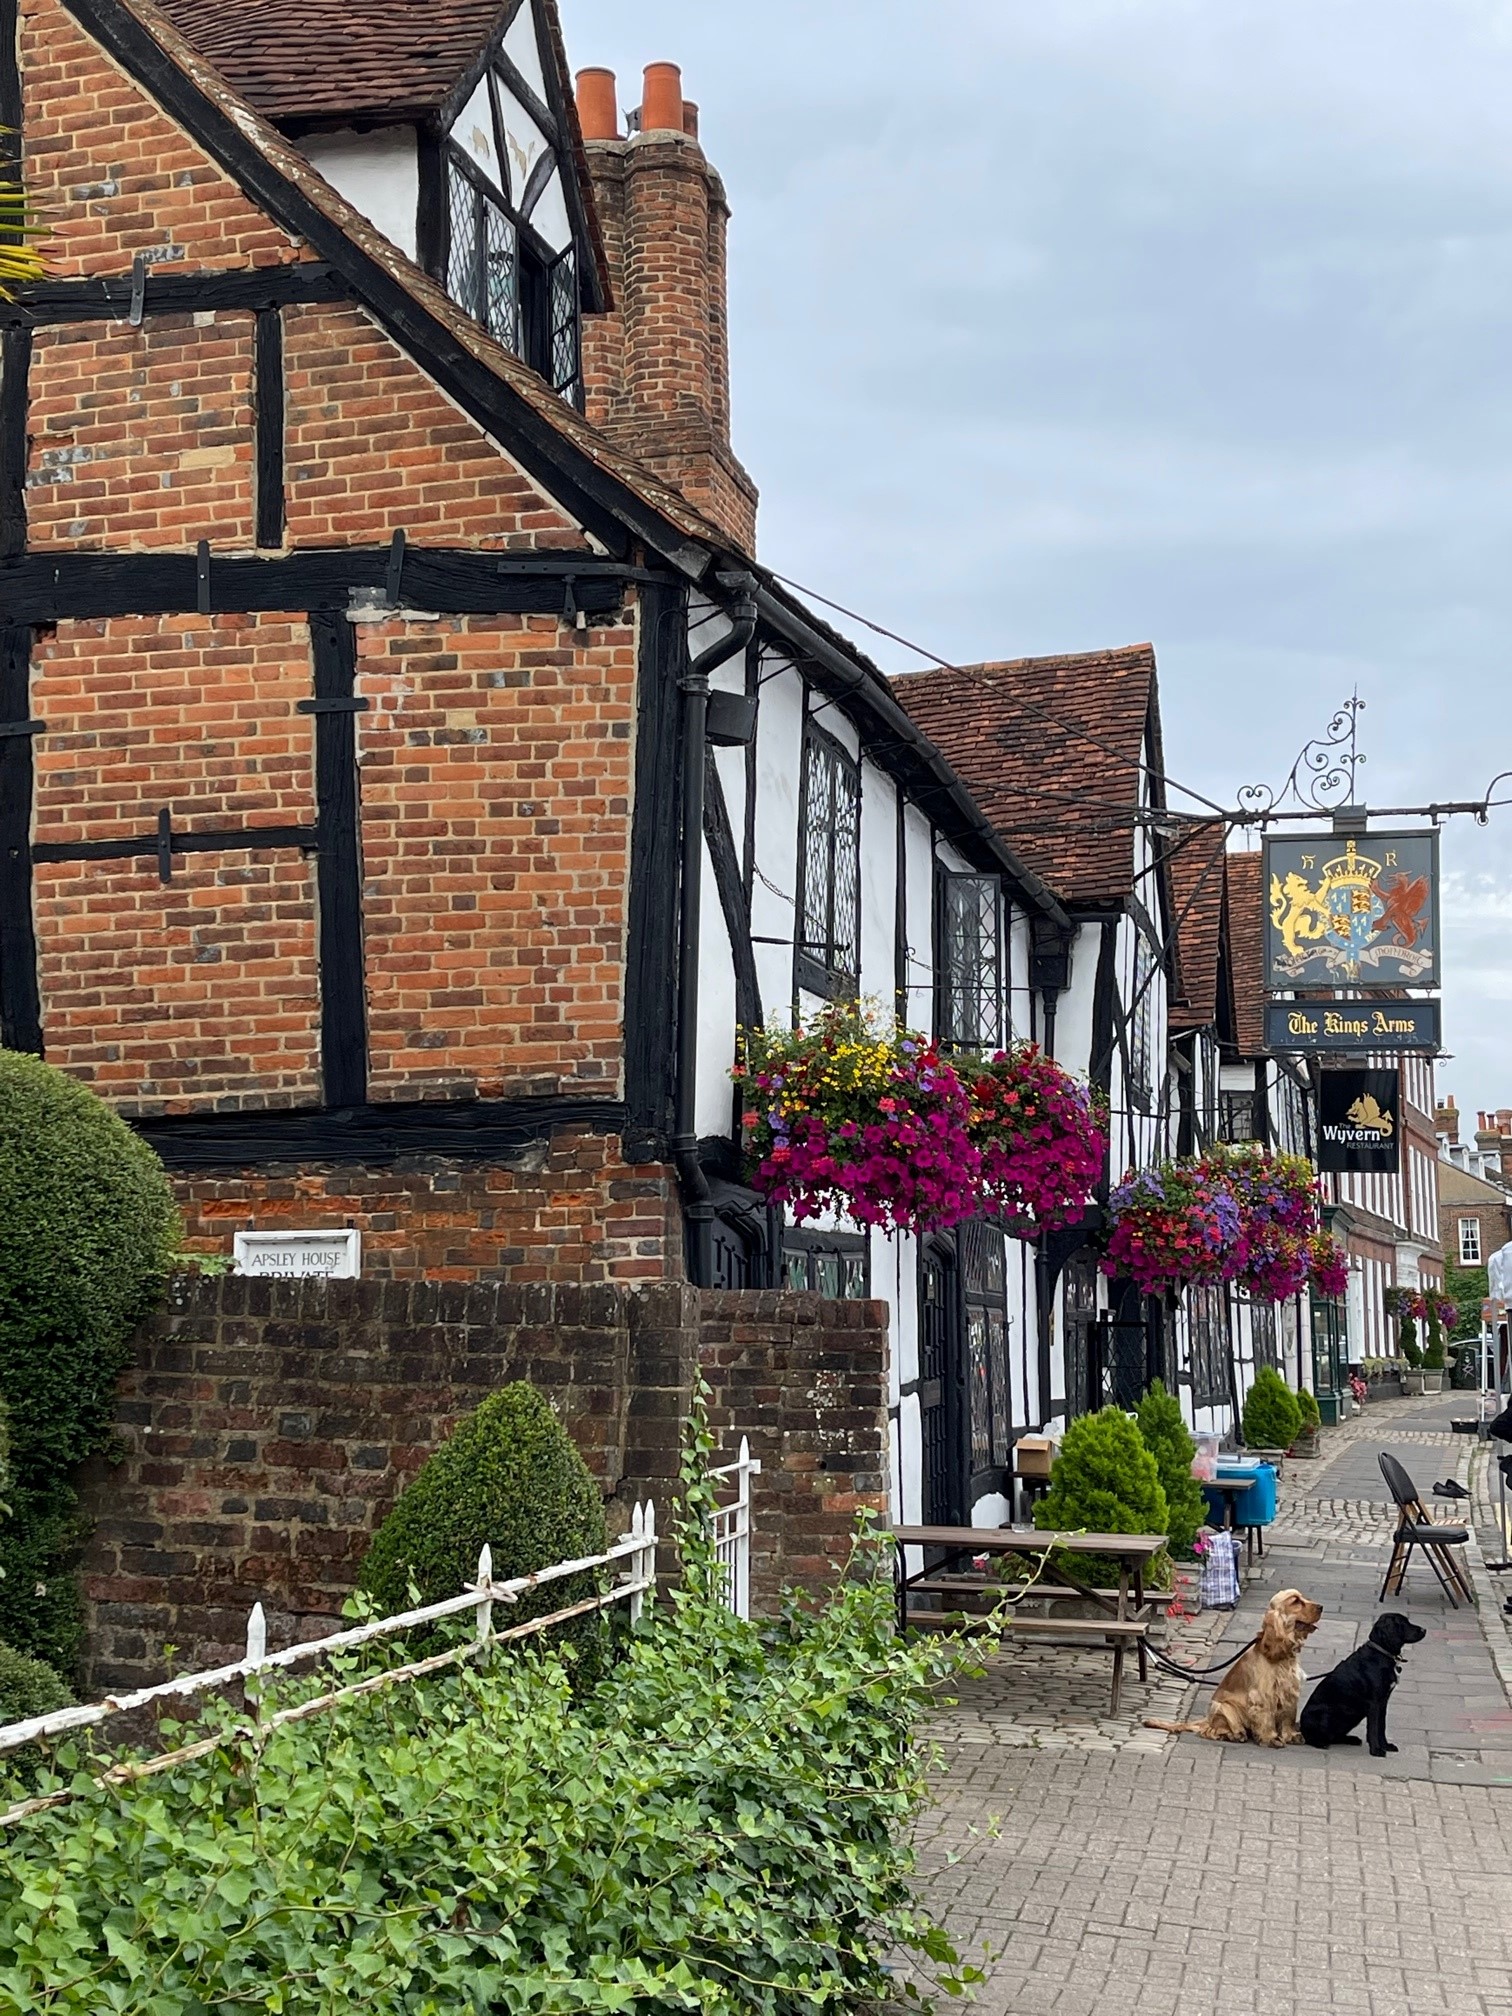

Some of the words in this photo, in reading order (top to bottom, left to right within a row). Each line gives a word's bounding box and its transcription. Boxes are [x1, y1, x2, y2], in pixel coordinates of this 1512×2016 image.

[1385, 852, 1398, 867] R
[1288, 1011, 1319, 1035] The
[1323, 1011, 1369, 1038] Kings
[1371, 1010, 1415, 1037] Arms
[1322, 1125, 1381, 1144] Wyvern
[1346, 1142, 1395, 1150] RESTAURANT
[251, 1253, 297, 1267] APSLEY
[301, 1252, 341, 1266] HOUSE
